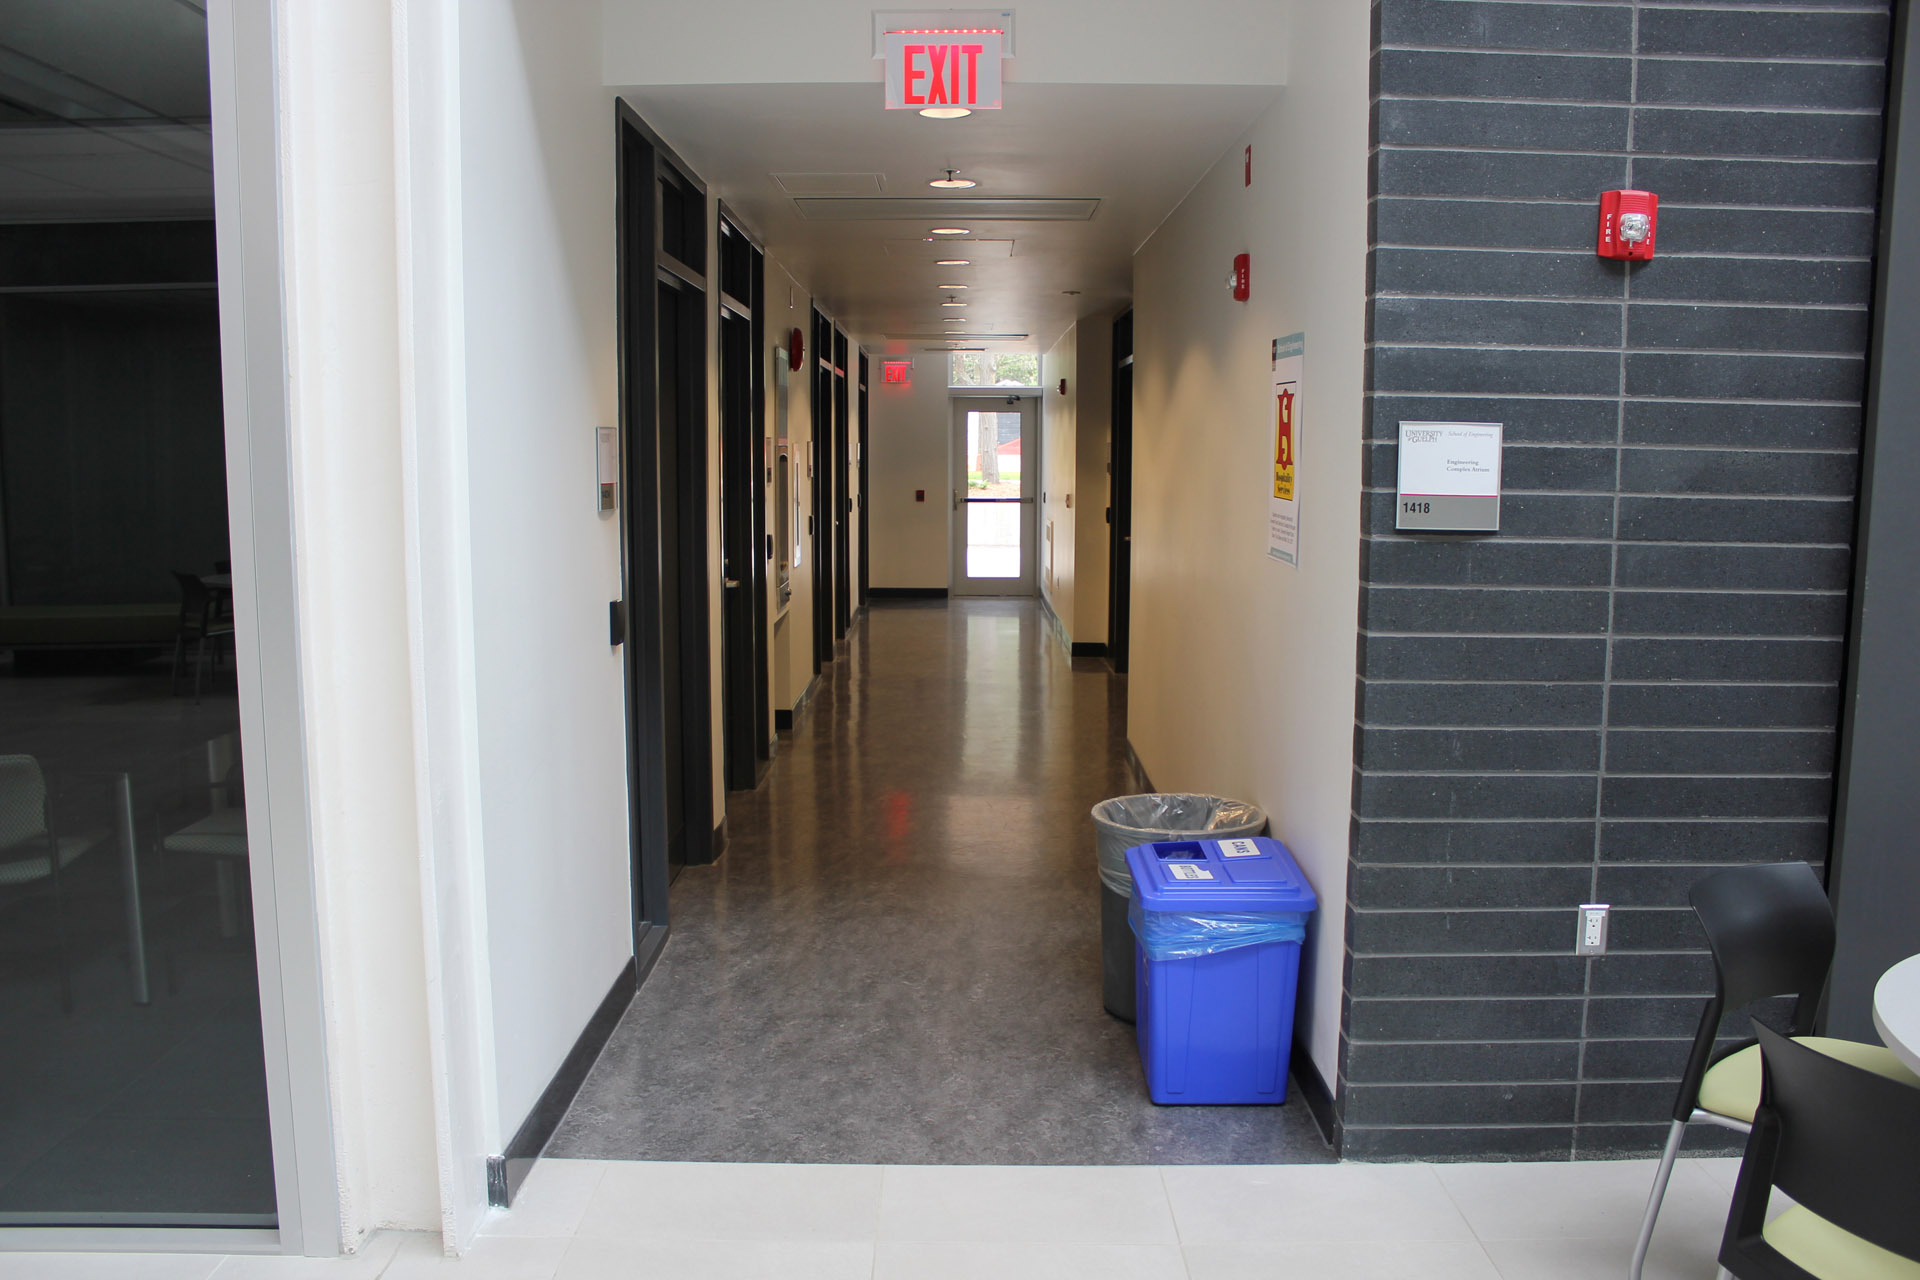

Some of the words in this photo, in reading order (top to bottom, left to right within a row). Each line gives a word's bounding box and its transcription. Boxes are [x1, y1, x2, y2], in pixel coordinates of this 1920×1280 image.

[904, 45, 983, 104] EXIT
[885, 365, 907, 382] EXIT
[1405, 430, 1443, 438] UNIVERSITY
[1403, 502, 1430, 514] 1418
[1232, 841, 1250, 854] CANS
